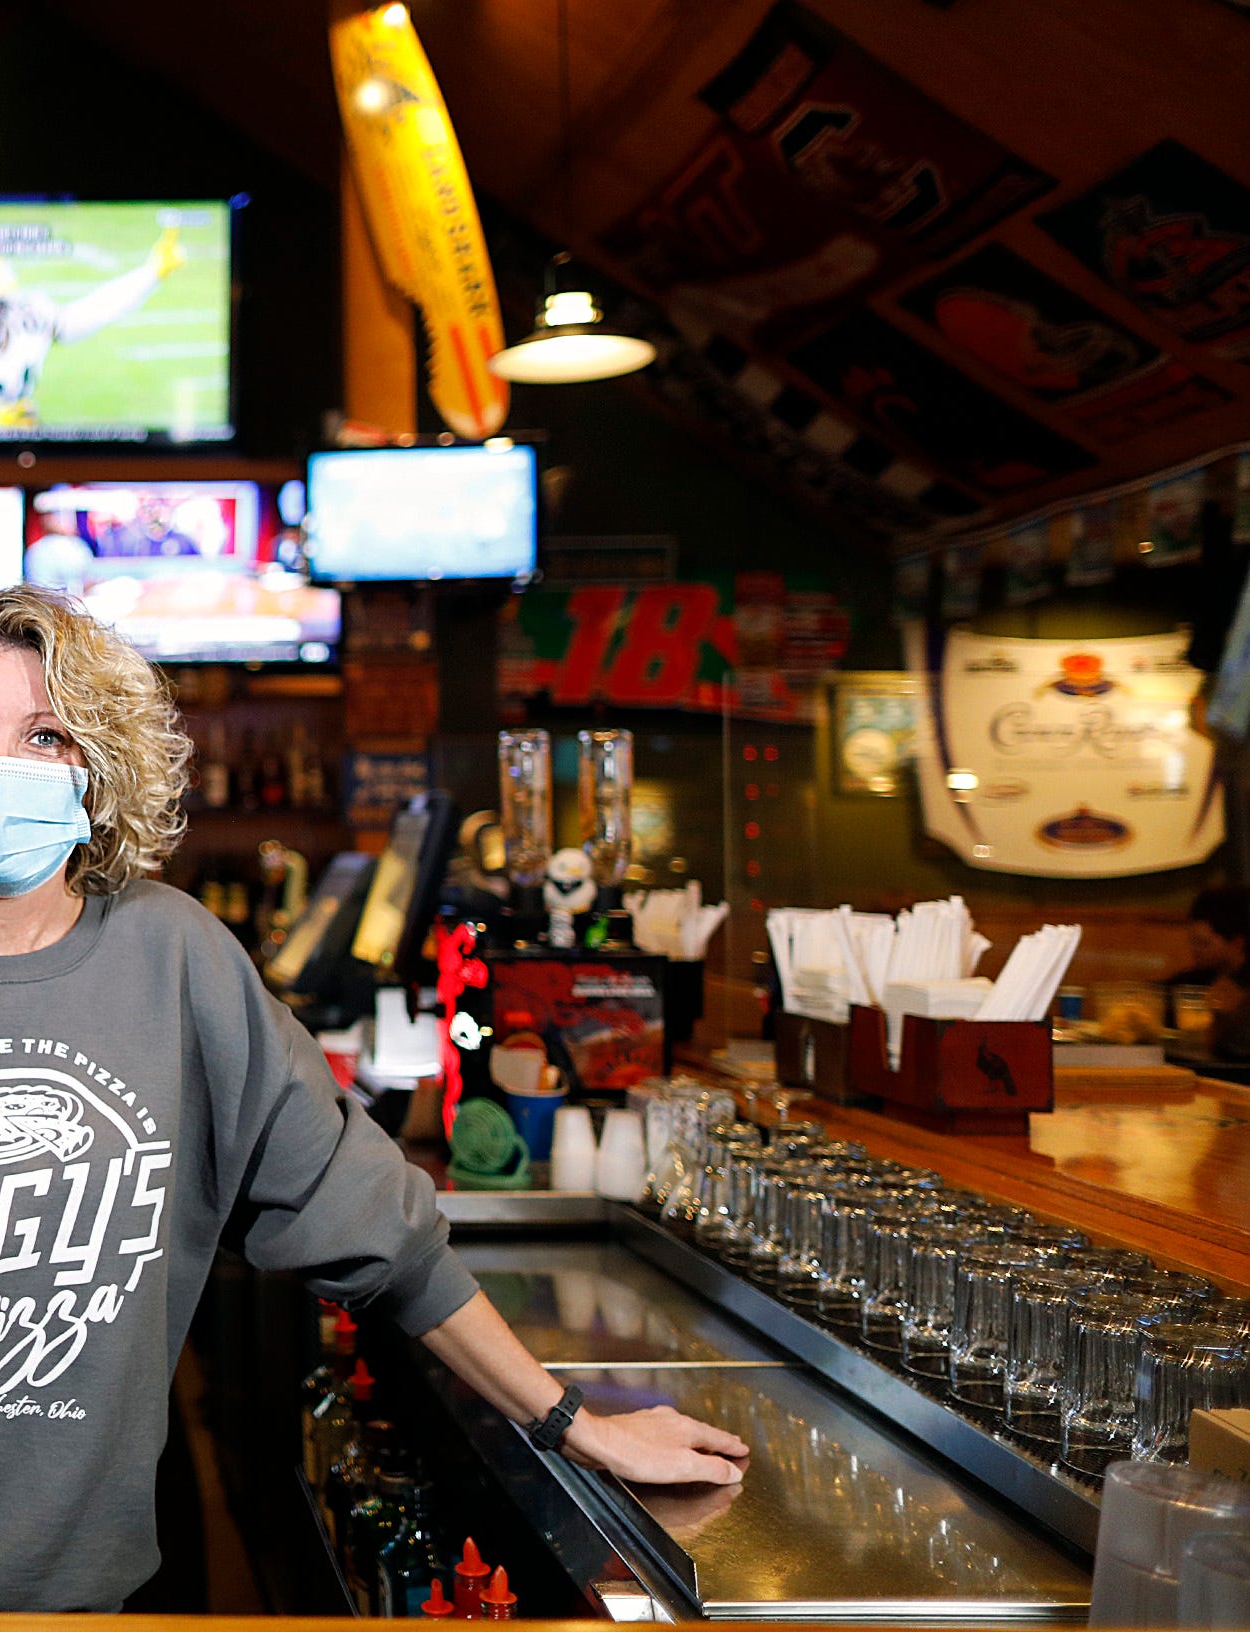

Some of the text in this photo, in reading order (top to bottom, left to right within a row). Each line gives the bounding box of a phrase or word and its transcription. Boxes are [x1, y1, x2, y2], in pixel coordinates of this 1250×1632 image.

[552, 580, 720, 705] 18
[22, 1038, 69, 1059] THE
[74, 1052, 136, 1107] PIZZA
[136, 1107, 157, 1135] IS
[47, 1399, 87, 1420] Ohio
